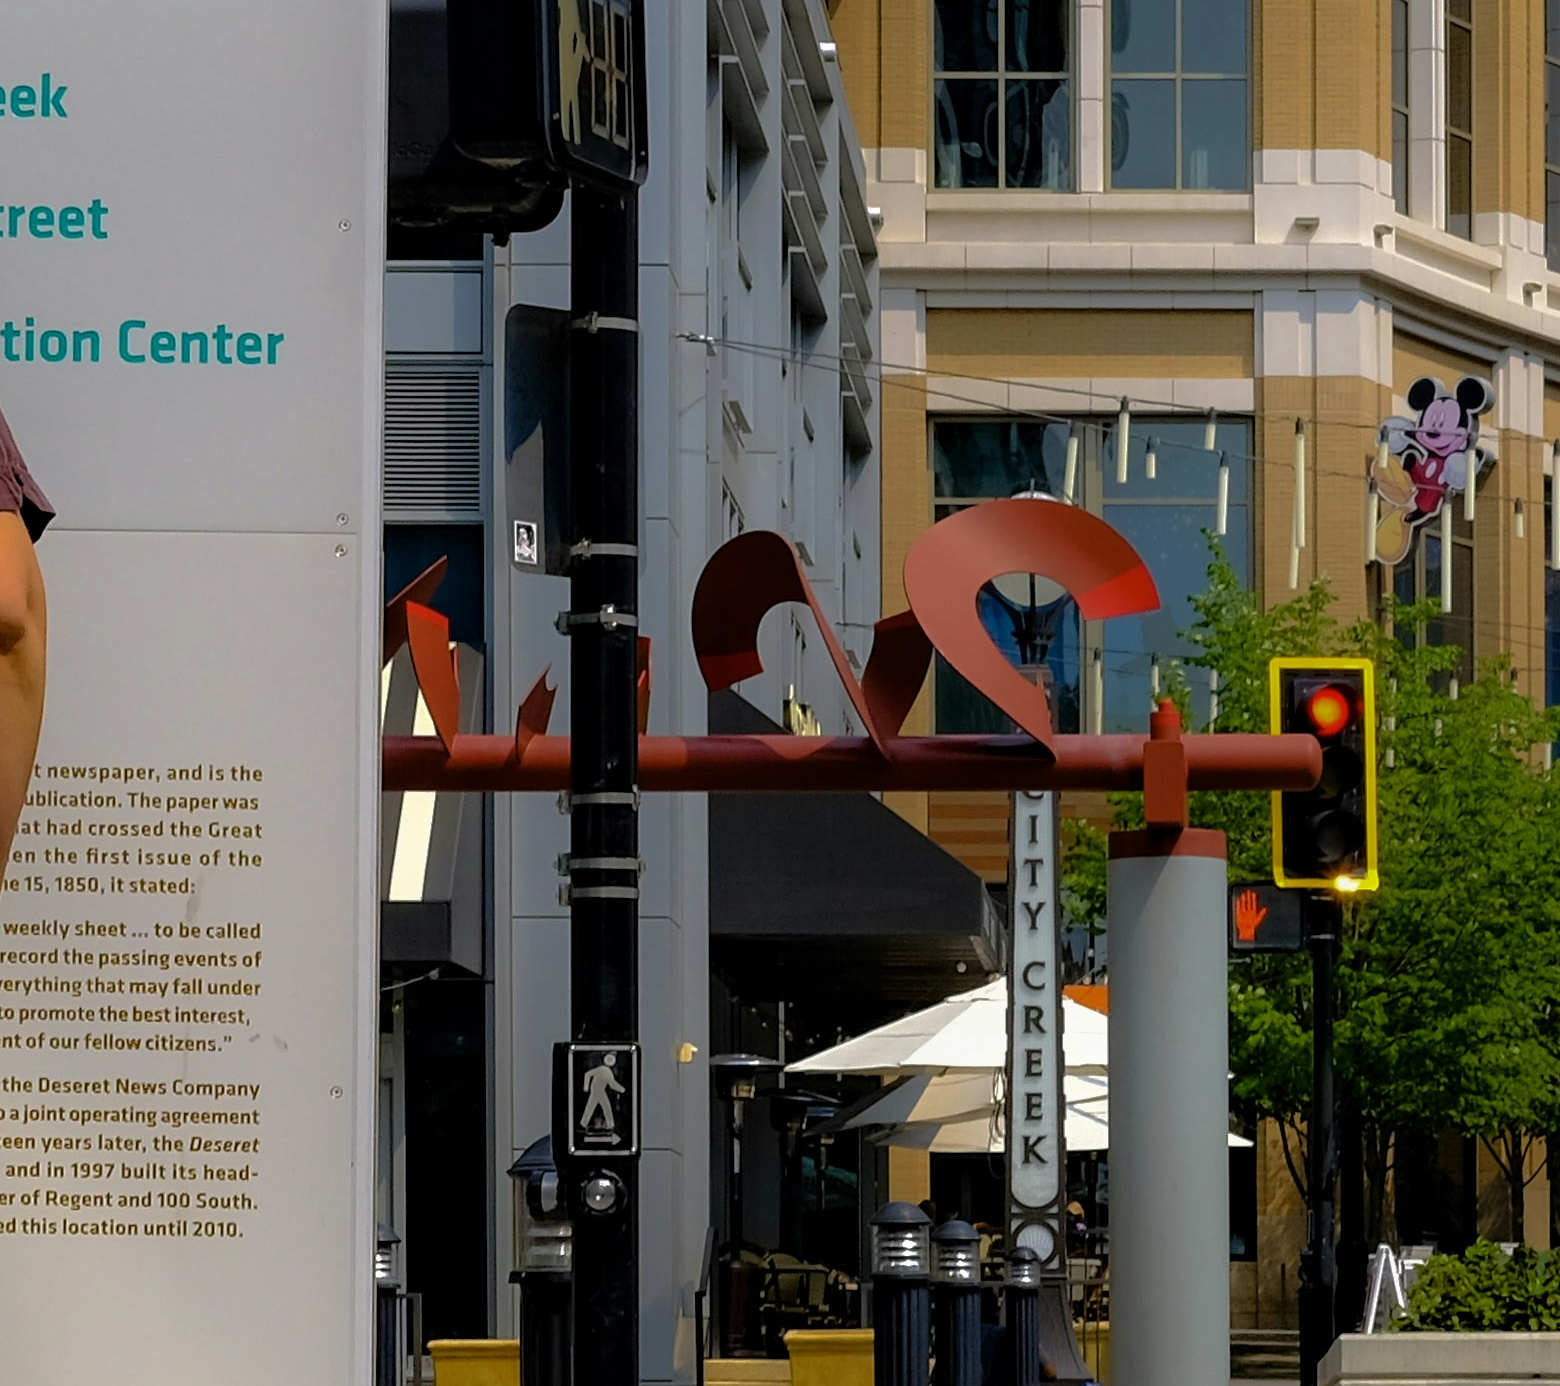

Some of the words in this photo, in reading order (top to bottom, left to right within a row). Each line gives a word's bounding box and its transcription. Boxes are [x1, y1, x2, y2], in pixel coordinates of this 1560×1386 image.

[117, 318, 285, 365] Center
[47, 766, 161, 785] newspaper,
[167, 763, 202, 781] and
[209, 764, 225, 781] is
[230, 765, 263, 782] the
[25, 788, 123, 808] ublication.
[126, 791, 162, 809] The
[166, 796, 220, 814] paper
[222, 797, 259, 811] was
[47, 818, 82, 836] had
[88, 819, 164, 837] crossed
[169, 820, 203, 838] the
[208, 821, 263, 839] Great
[44, 846, 78, 865] the
[86, 847, 130, 865] first
[138, 848, 192, 866] issue
[200, 849, 222, 867] of
[228, 849, 262, 867] the
[1021, 790, 1046, 931] ITY
[24, 875, 50, 895] 15,
[54, 876, 106, 895] 1850,
[111, 875, 125, 894] it
[129, 877, 196, 894] stated:
[3, 919, 71, 941] weekly
[74, 920, 128, 938] sheet
[154, 922, 174, 939] to
[179, 921, 202, 939] be
[206, 922, 261, 940] called
[0, 946, 59, 965] record
[62, 947, 94, 965] the
[99, 948, 170, 971] passing
[174, 951, 238, 967] events
[242, 950, 262, 968] of
[86, 976, 126, 995] that
[129, 981, 169, 999] may
[172, 977, 203, 995] fall
[208, 978, 262, 996] under
[18, 1005, 96, 1026] promote
[98, 1004, 129, 1023] the
[132, 1005, 172, 1024] best
[175, 1006, 250, 1026] interest,
[26, 1031, 46, 1049] of
[49, 1036, 81, 1050] our
[83, 1032, 142, 1051] fellow
[1021, 960, 1048, 1165] CREEK
[2, 1075, 33, 1093] the
[38, 1077, 111, 1095] Deseret
[116, 1078, 167, 1095] News
[172, 1079, 260, 1100] Company
[9, 1108, 20, 1121] a
[22, 1104, 66, 1126] joint
[69, 1105, 158, 1127] operating
[161, 1109, 260, 1128] agreement
[41, 1137, 92, 1155] years
[98, 1133, 147, 1154] later,
[152, 1134, 184, 1152] the
[189, 1136, 261, 1153] Deseret
[5, 1159, 40, 1178] and
[47, 1160, 65, 1180] in
[70, 1162, 116, 1180] 1997
[121, 1159, 166, 1181] built
[172, 1162, 197, 1181] its
[204, 1163, 259, 1182] head-
[20, 1188, 41, 1208] of
[45, 1190, 114, 1212] Regent
[118, 1190, 152, 1208] and
[157, 1191, 191, 1209] 100
[196, 1192, 258, 1210] South.
[20, 1216, 57, 1235] this
[63, 1217, 138, 1236] location
[144, 1219, 188, 1237] until
[192, 1220, 244, 1238] 2010.
